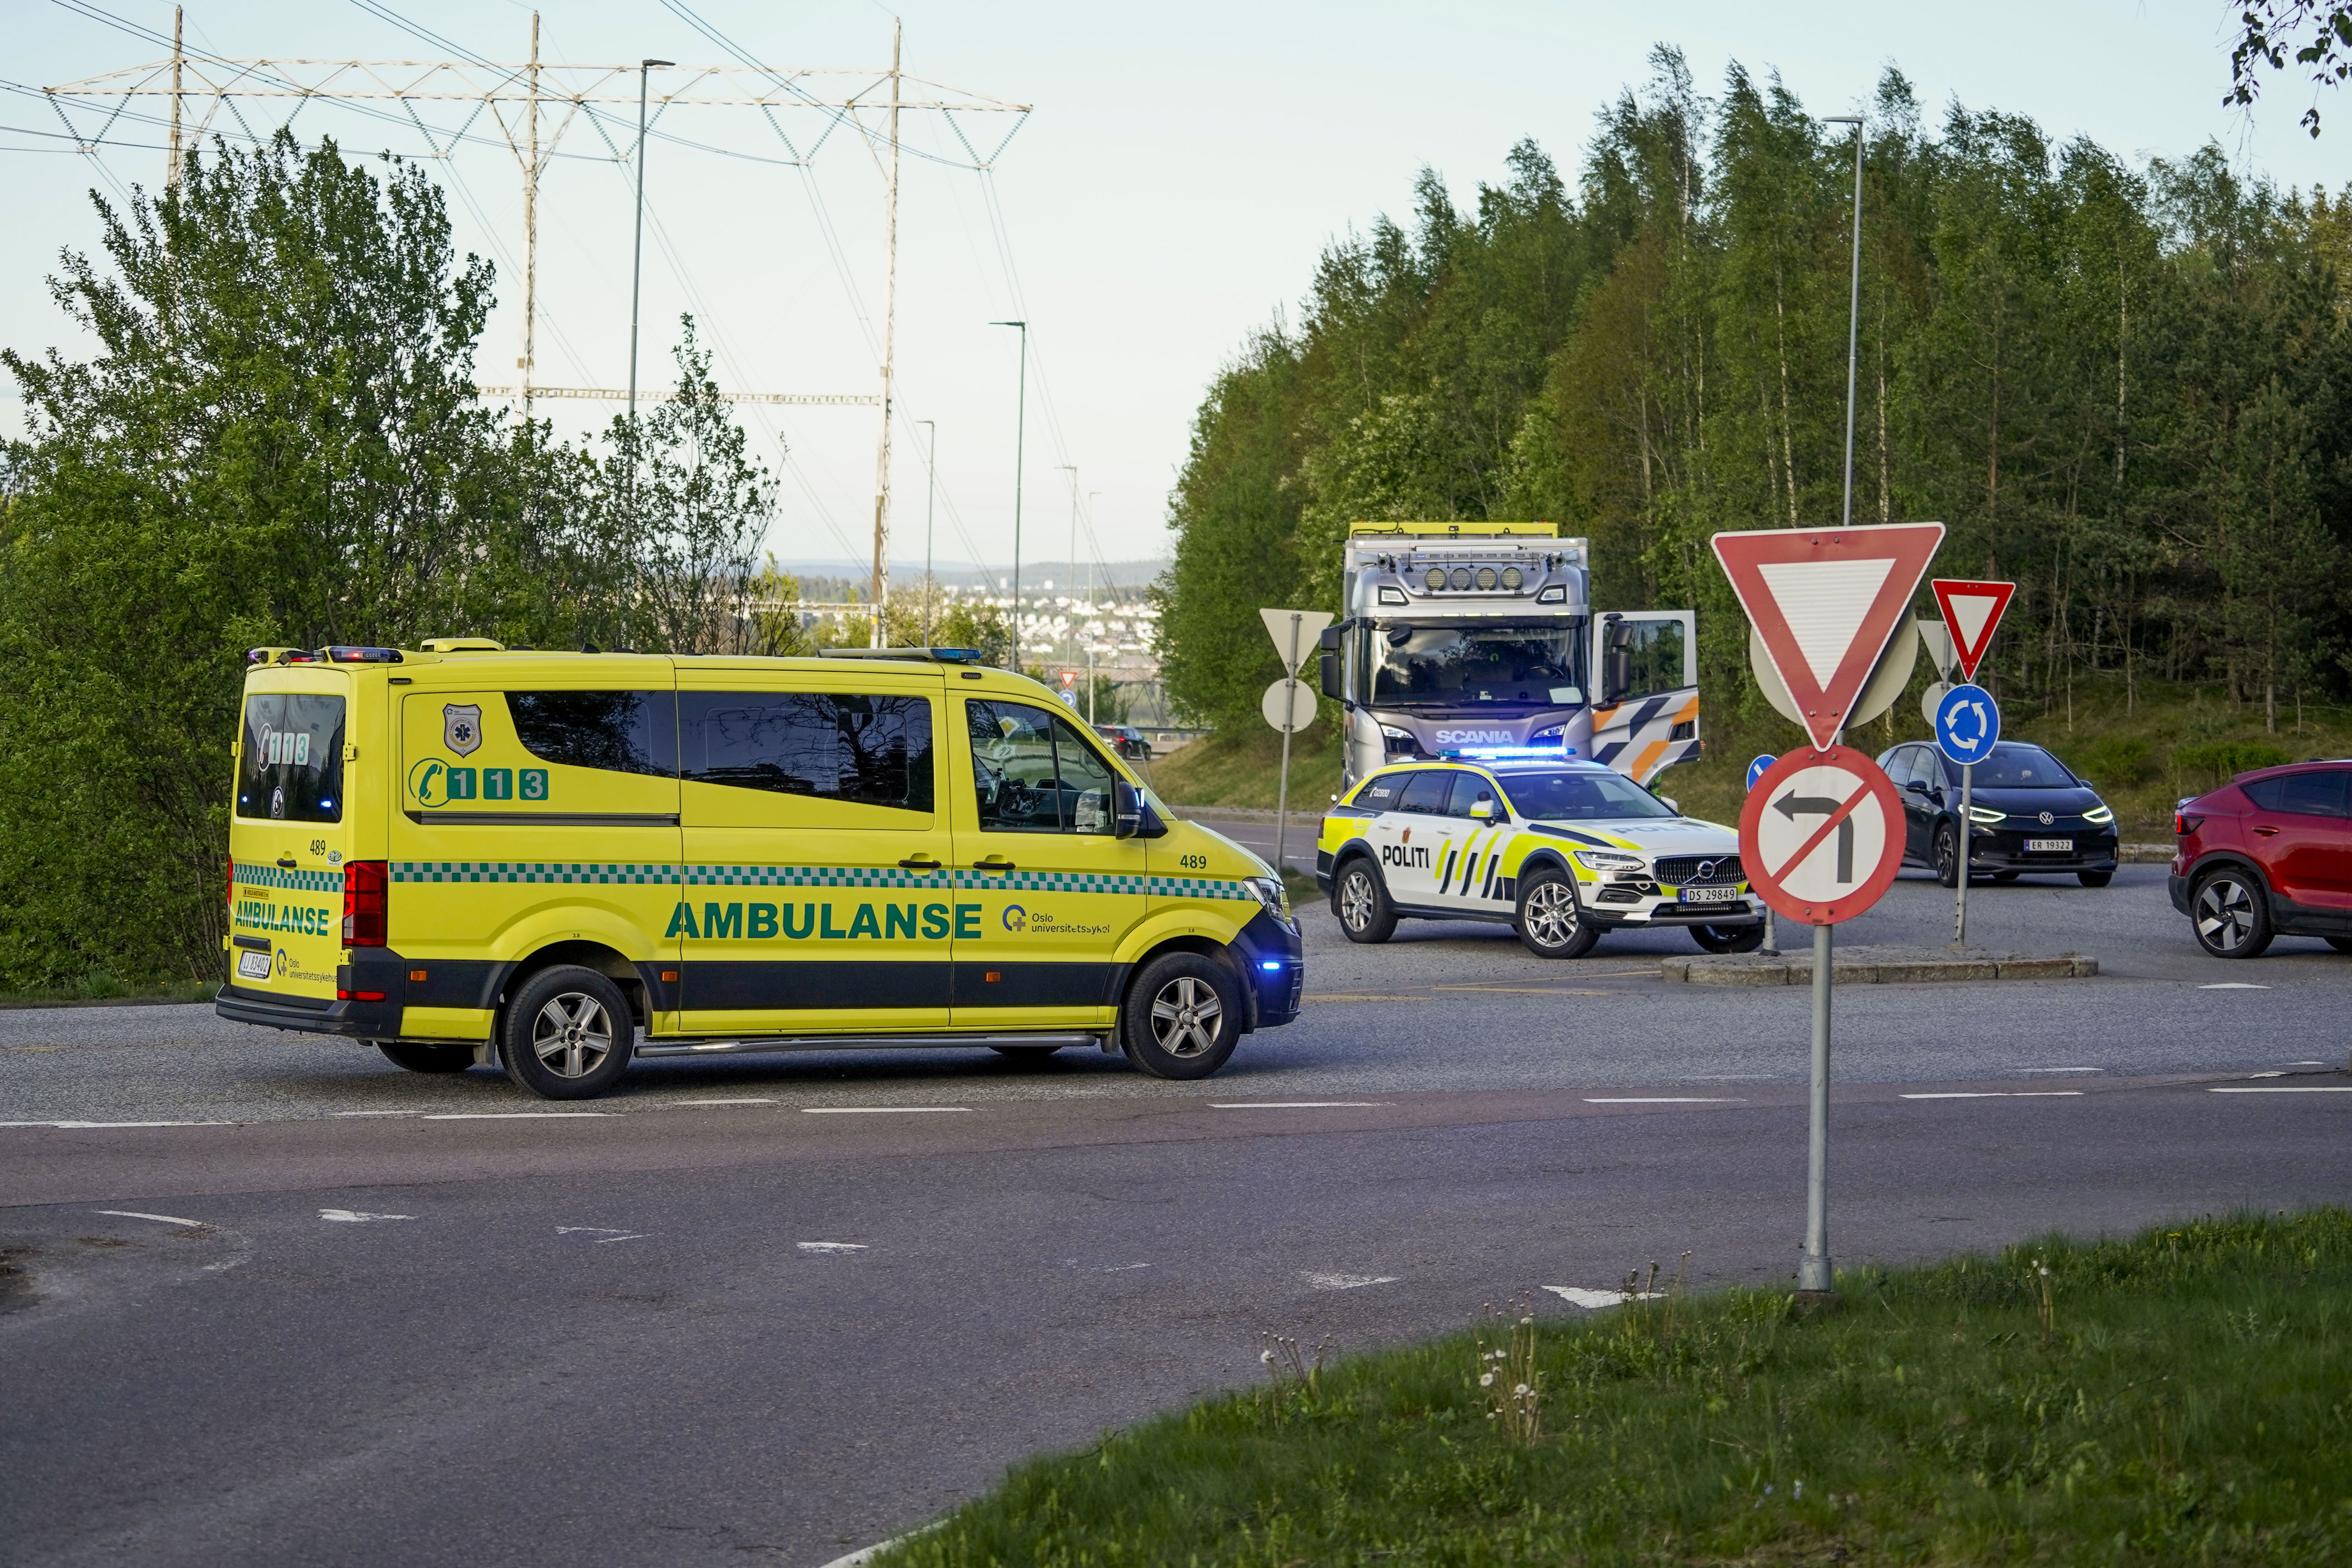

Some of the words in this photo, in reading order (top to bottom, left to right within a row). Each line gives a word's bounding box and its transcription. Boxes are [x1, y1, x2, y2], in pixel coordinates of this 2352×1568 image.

[1435, 730, 1515, 744] SCANIA
[272, 735, 306, 762] 113
[454, 770, 544, 799] 113
[310, 839, 325, 856] 489
[2032, 841, 2042, 849] ER
[2046, 841, 2070, 849] 19322
[1180, 854, 1207, 869] 489
[1382, 845, 1429, 868] POLITI
[1689, 890, 1701, 901] DS
[1706, 889, 1735, 900] 29849
[235, 900, 329, 937] AMBULANSE
[664, 901, 983, 939] AMBULANSE
[1032, 913, 1053, 922] Oslo
[243, 954, 251, 969] LJ
[250, 955, 269, 972] 83402
[289, 958, 300, 968] Oslo
[289, 969, 338, 983] universitetssykehus
